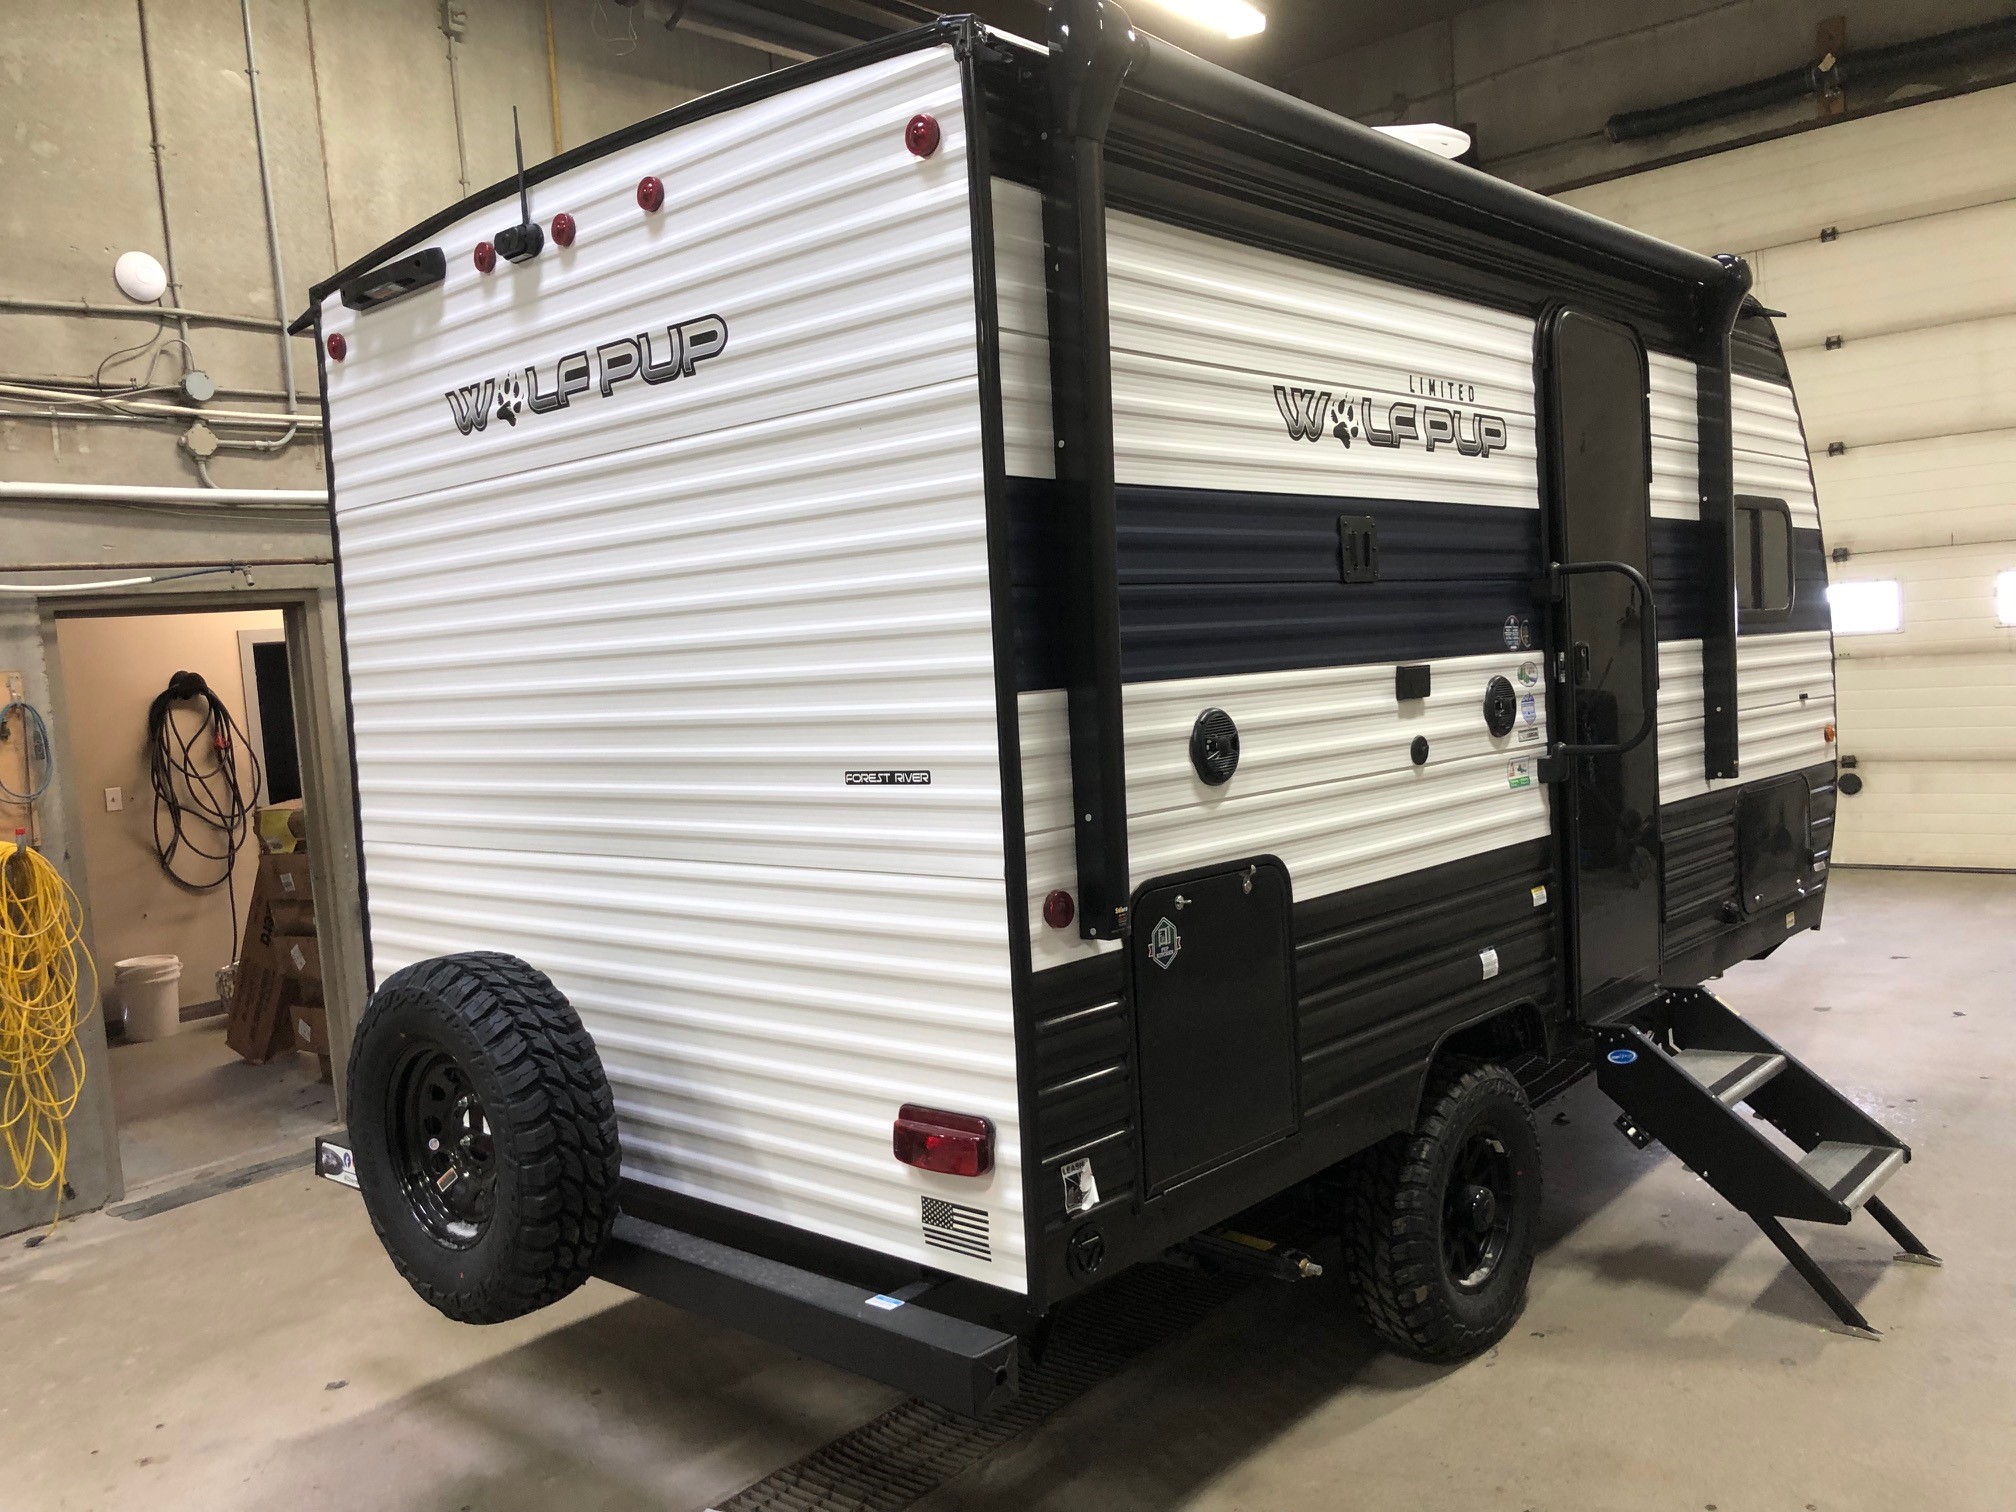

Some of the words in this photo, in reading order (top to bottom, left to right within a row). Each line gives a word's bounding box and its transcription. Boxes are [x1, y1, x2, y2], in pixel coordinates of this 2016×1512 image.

[596, 313, 728, 398] PUP
[1409, 375, 1475, 402] LIMITED
[1424, 405, 1507, 459] PUP
[845, 773, 891, 783] FOREST
[894, 772, 929, 783] RIVER
